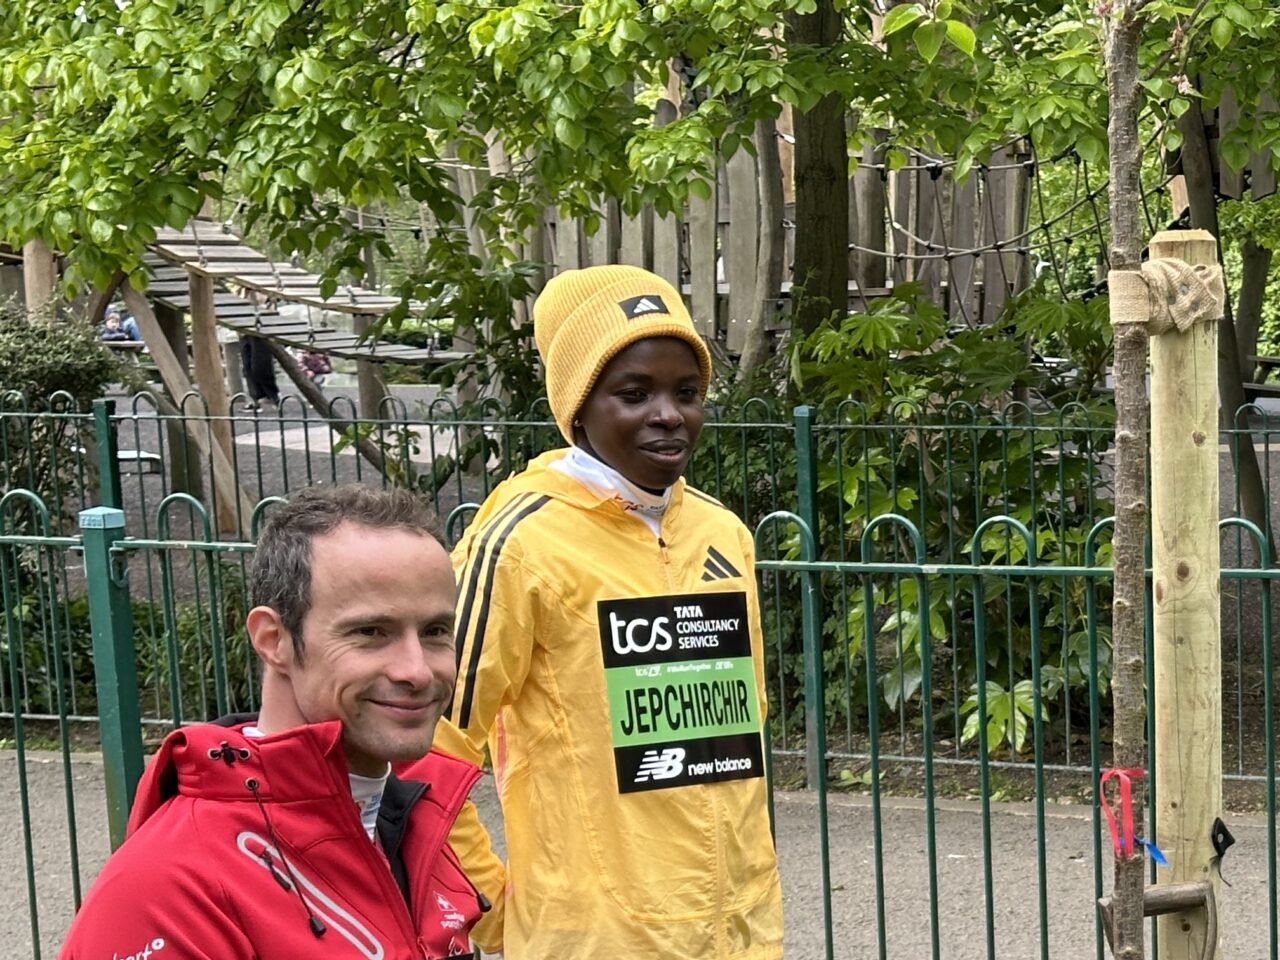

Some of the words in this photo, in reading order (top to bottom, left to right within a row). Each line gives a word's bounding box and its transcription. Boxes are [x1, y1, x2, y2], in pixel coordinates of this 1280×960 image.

[673, 605, 703, 619] TATA
[609, 611, 673, 655] tcs
[676, 618, 739, 635] CONSULTANCY
[678, 634, 719, 650] SERVICES
[620, 679, 751, 736] JEPCHIRCHIR
[687, 761, 715, 776] new
[714, 757, 752, 773] balance
